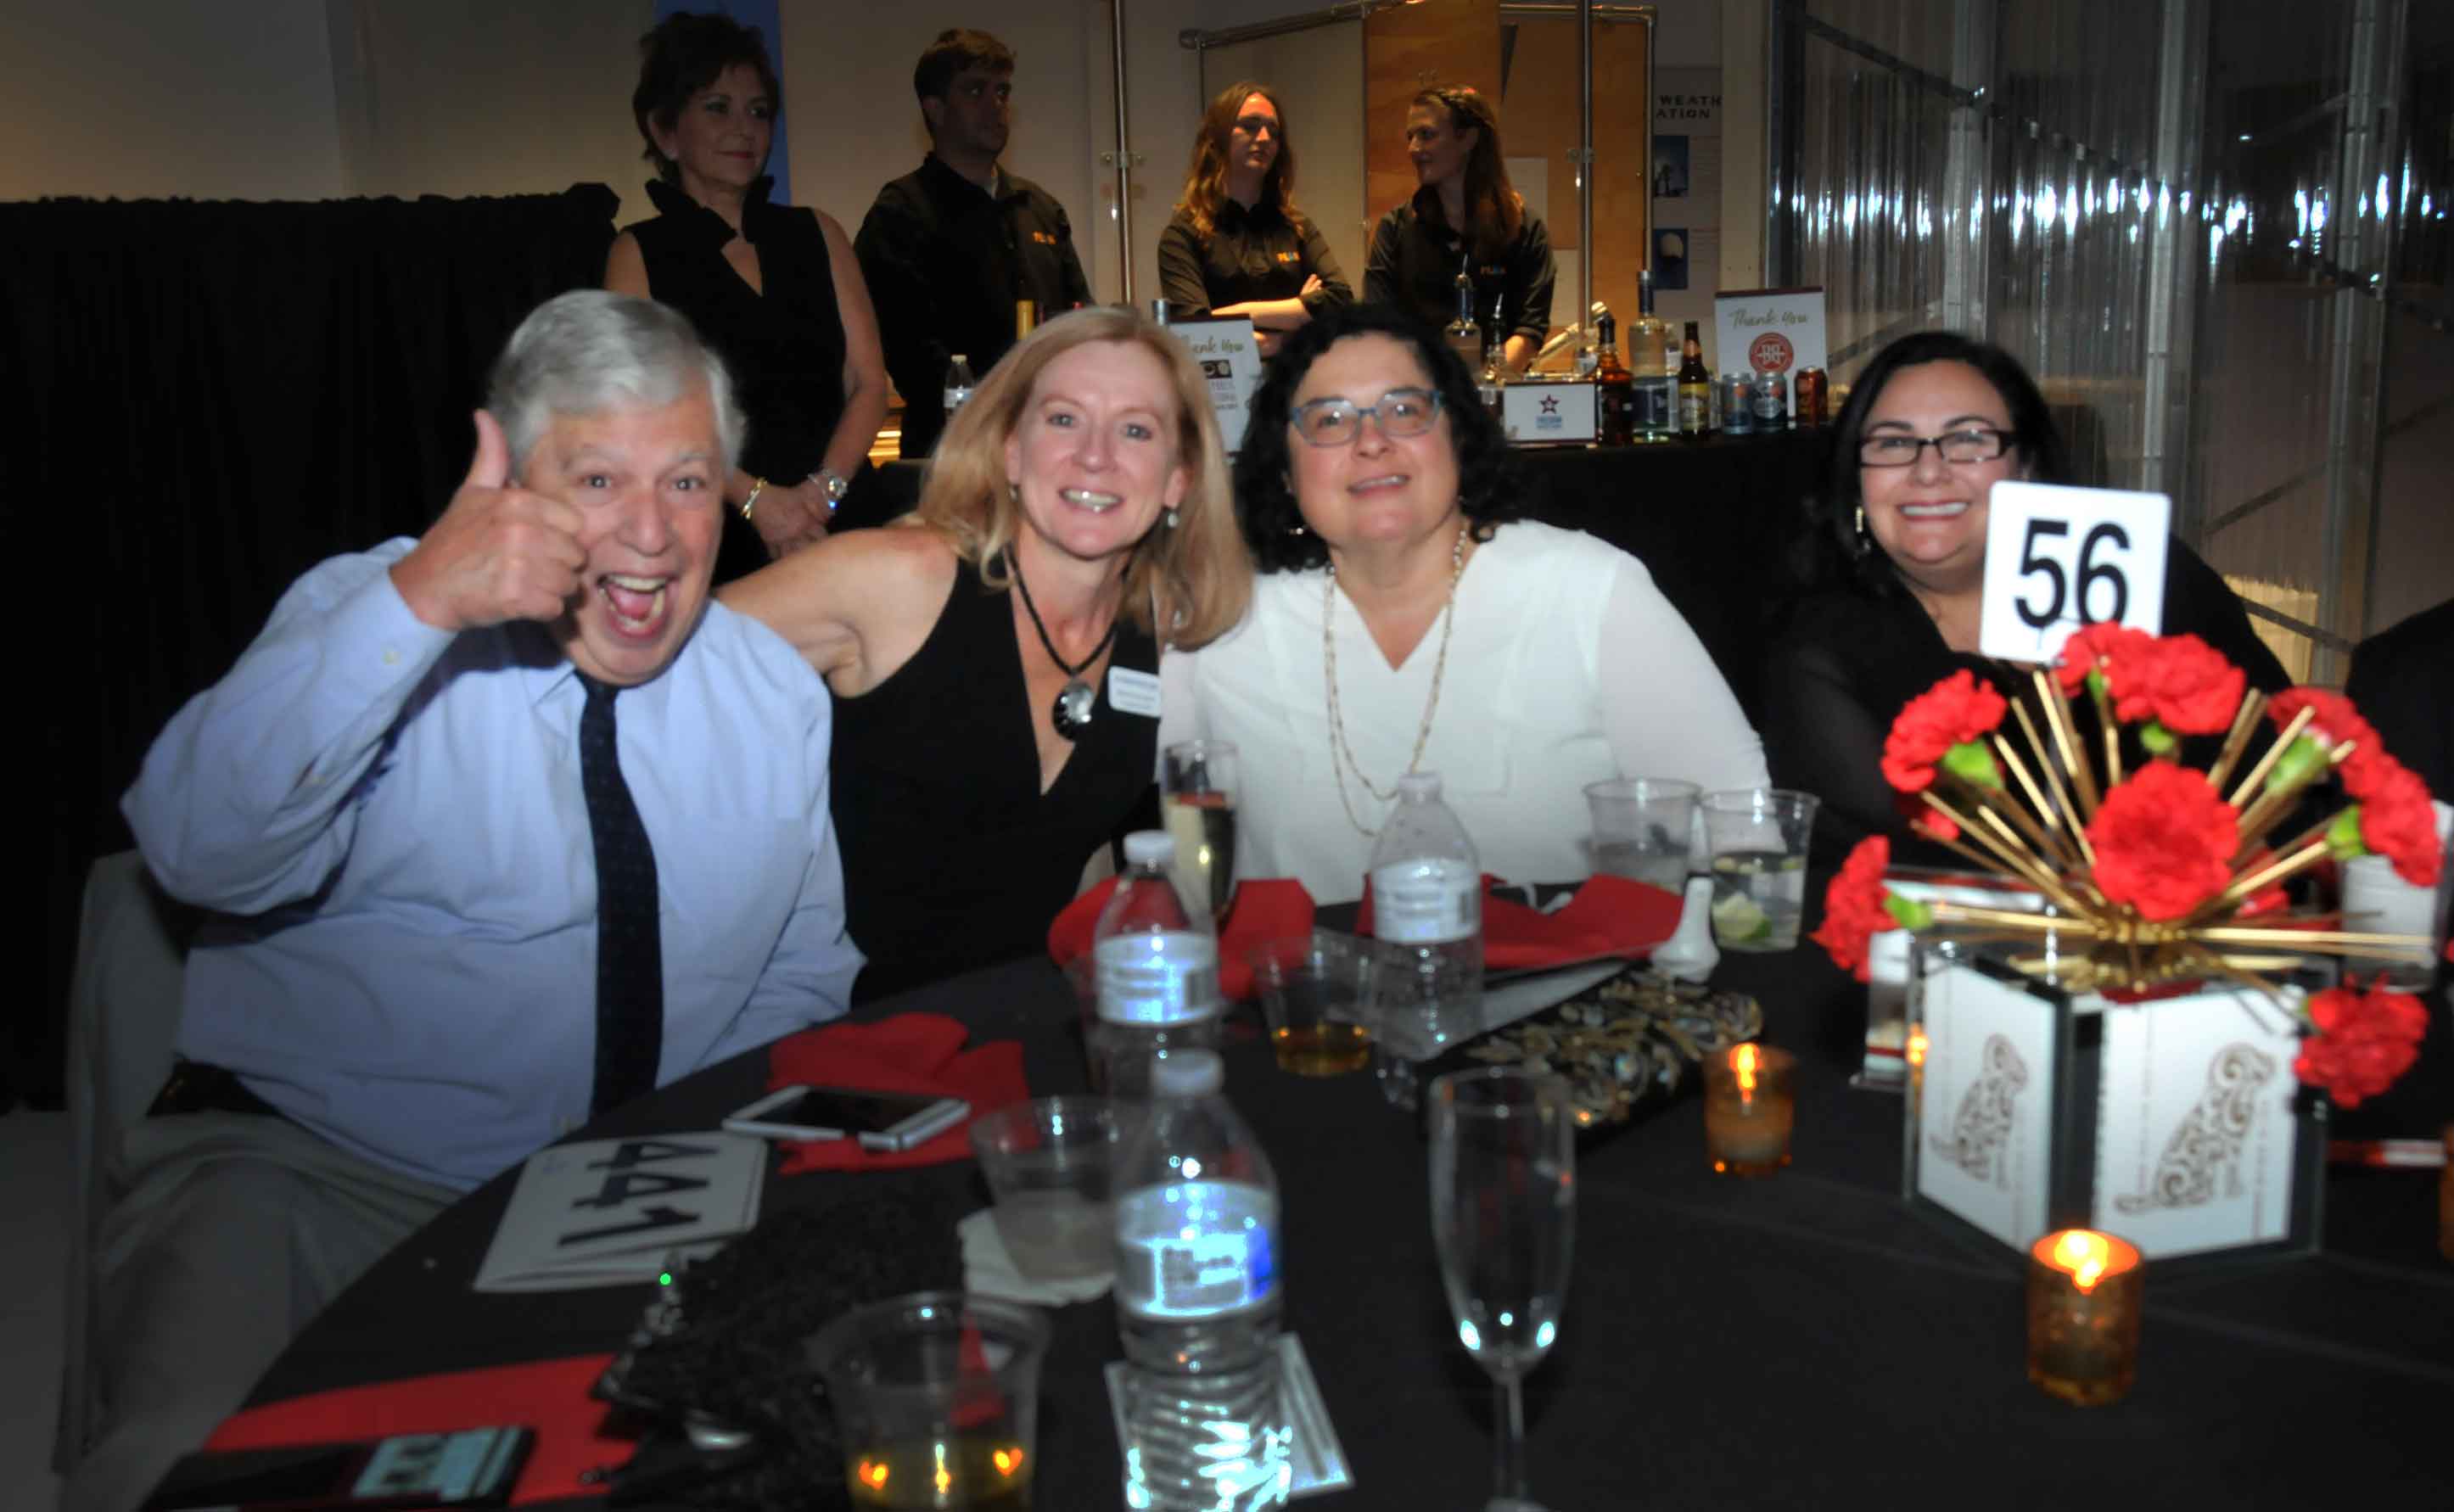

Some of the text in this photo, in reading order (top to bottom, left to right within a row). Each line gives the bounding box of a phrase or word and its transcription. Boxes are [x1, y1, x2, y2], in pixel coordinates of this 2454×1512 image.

[1656, 109, 1711, 120] ATION
[1728, 308, 1776, 329] Thank
[2014, 518, 2131, 629] 56
[558, 1141, 719, 1247] 441
